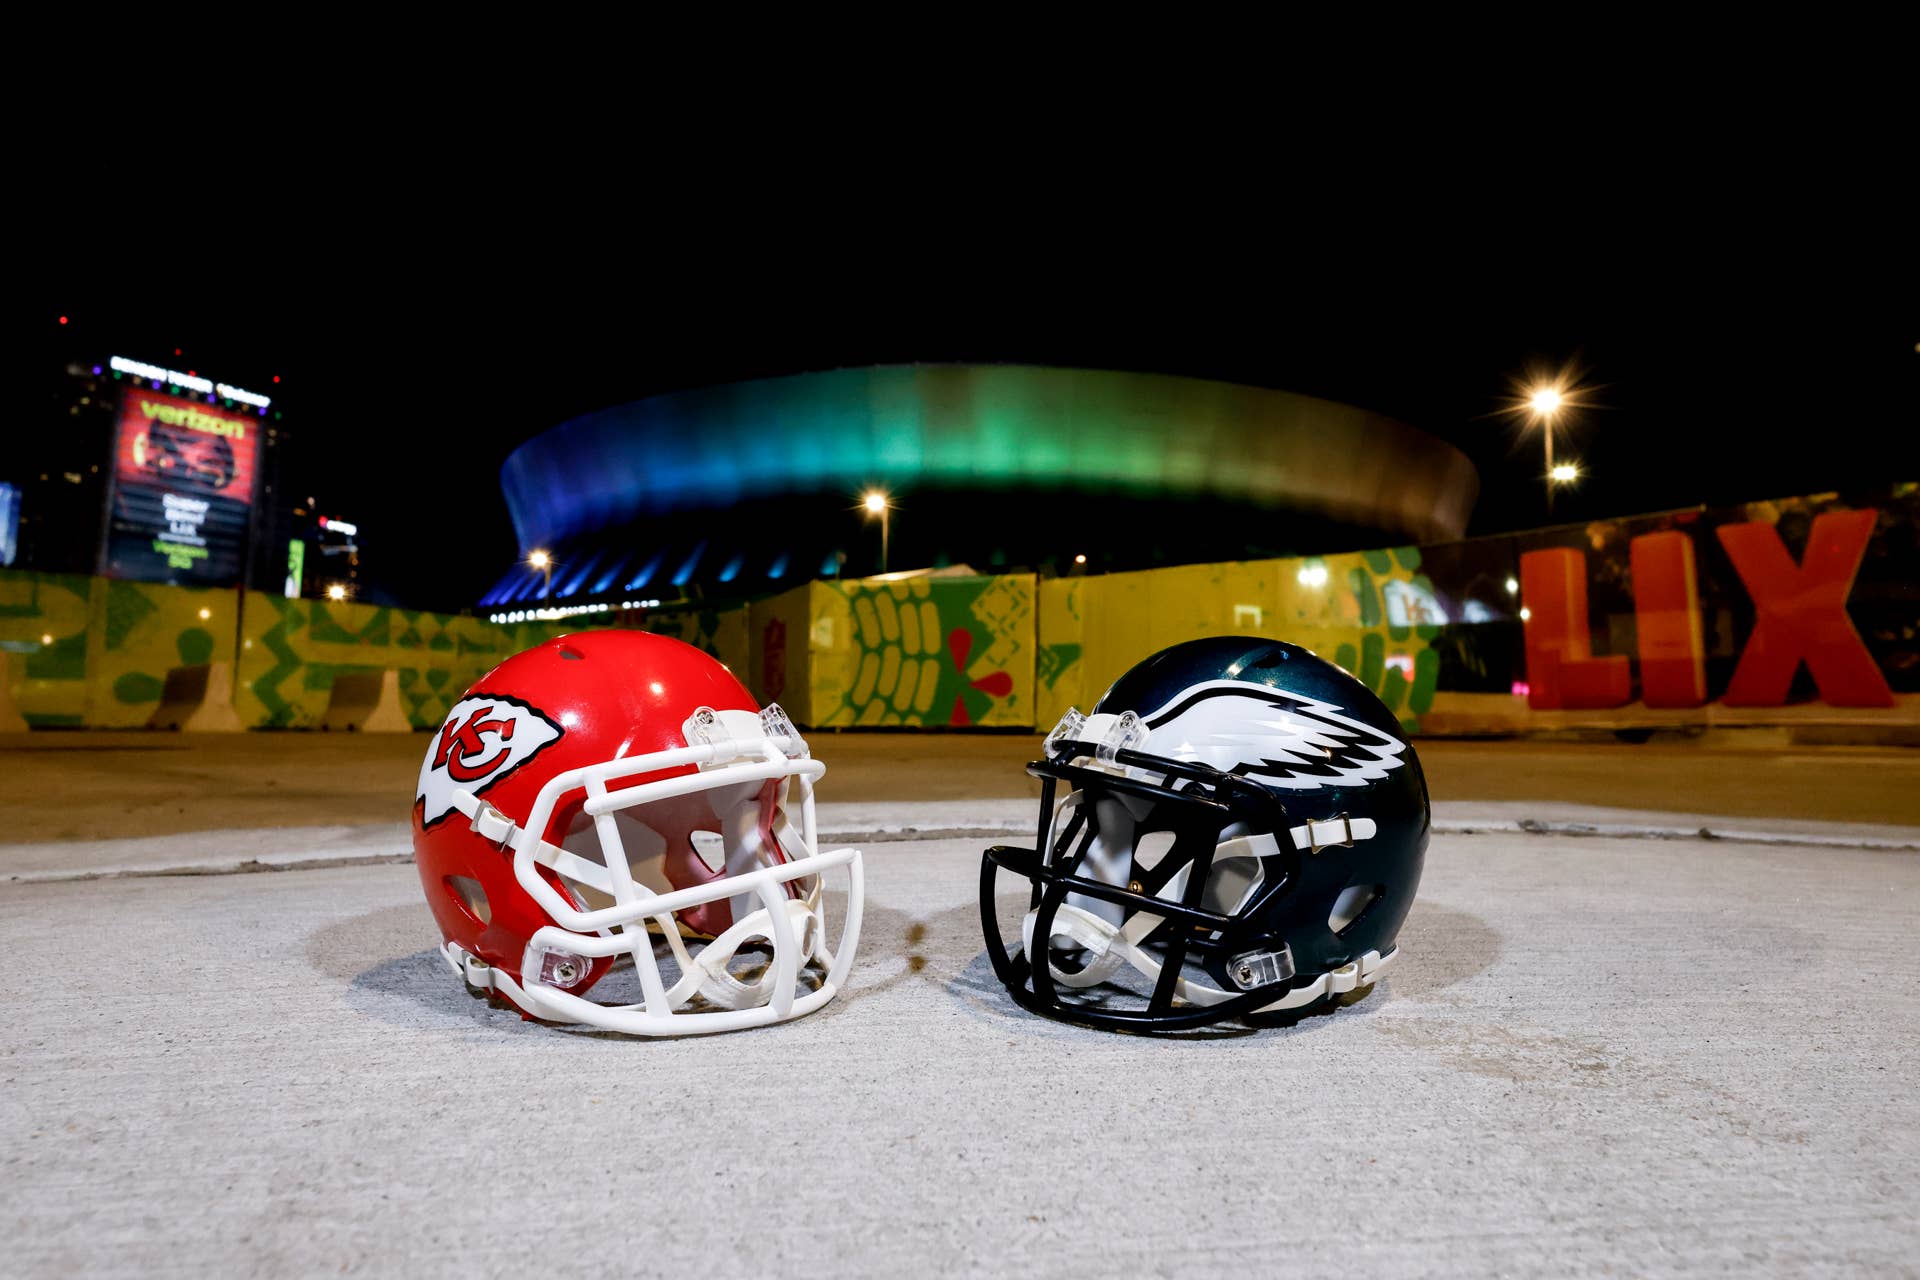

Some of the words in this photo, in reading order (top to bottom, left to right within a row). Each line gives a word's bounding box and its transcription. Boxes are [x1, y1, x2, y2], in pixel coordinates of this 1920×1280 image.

[141, 400, 245, 439] verizon
[1520, 508, 1893, 709] LIX
[432, 706, 516, 783] KC
